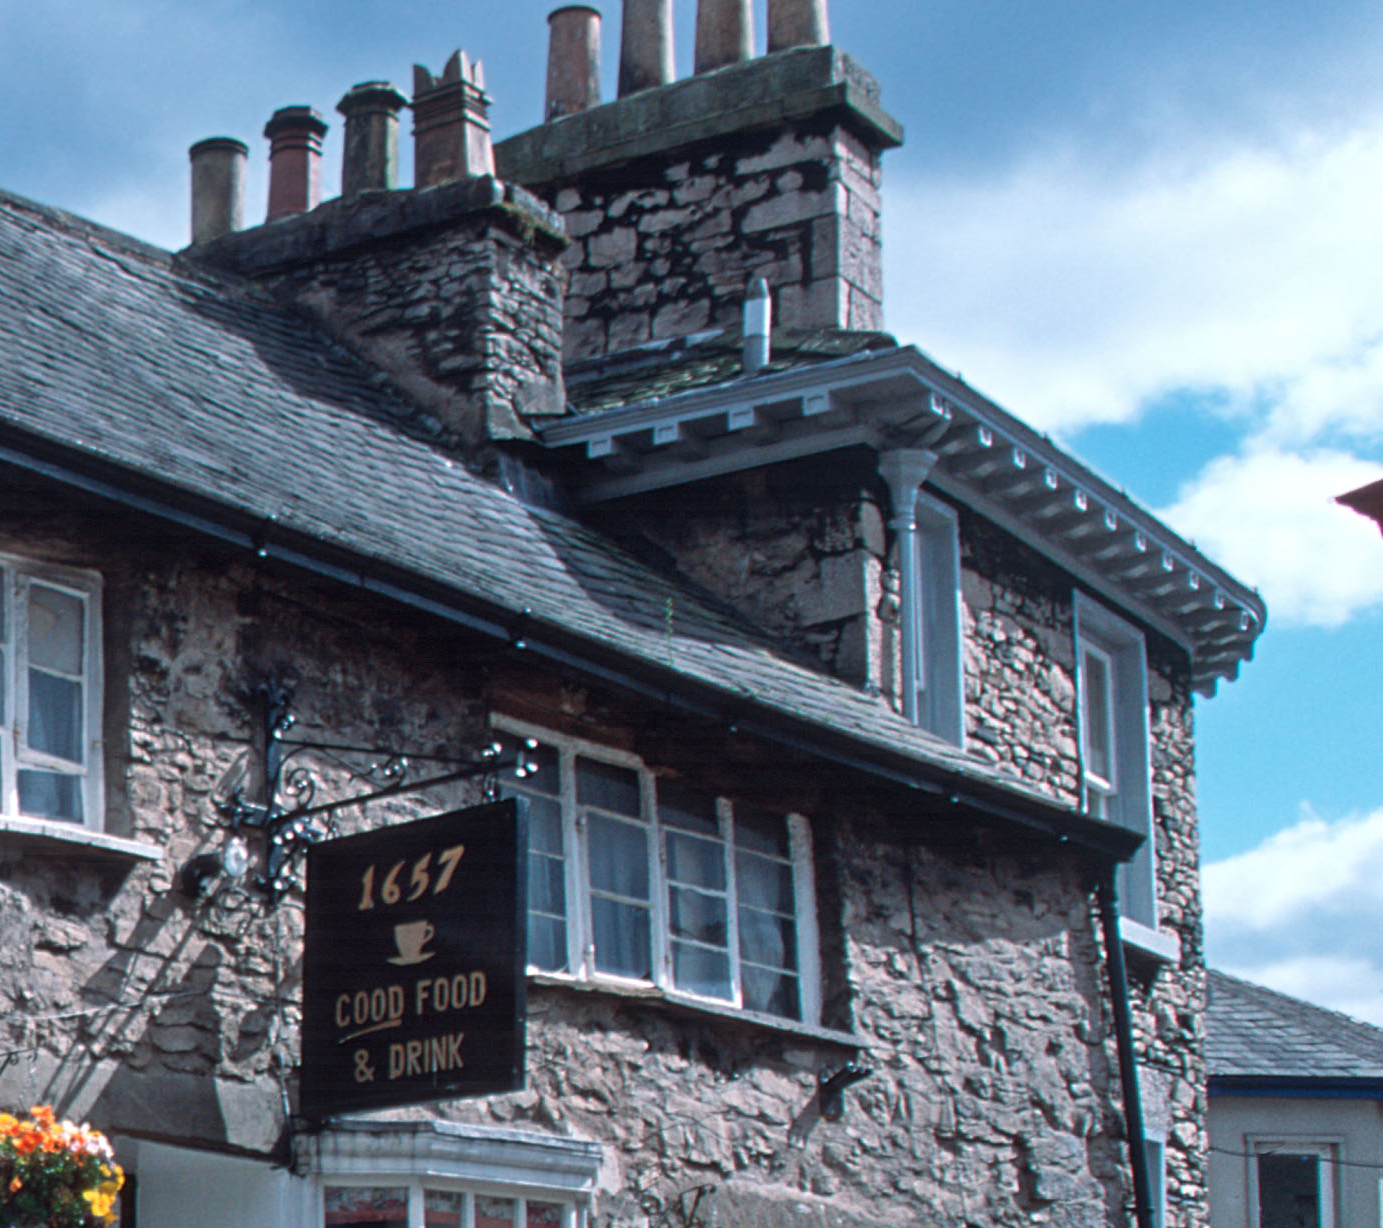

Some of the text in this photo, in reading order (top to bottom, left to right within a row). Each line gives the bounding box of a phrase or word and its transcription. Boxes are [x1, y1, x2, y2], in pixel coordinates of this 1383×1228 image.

[359, 845, 465, 910] 1657
[416, 971, 487, 1015] FOOD
[353, 1032, 465, 1083] & DRINK
